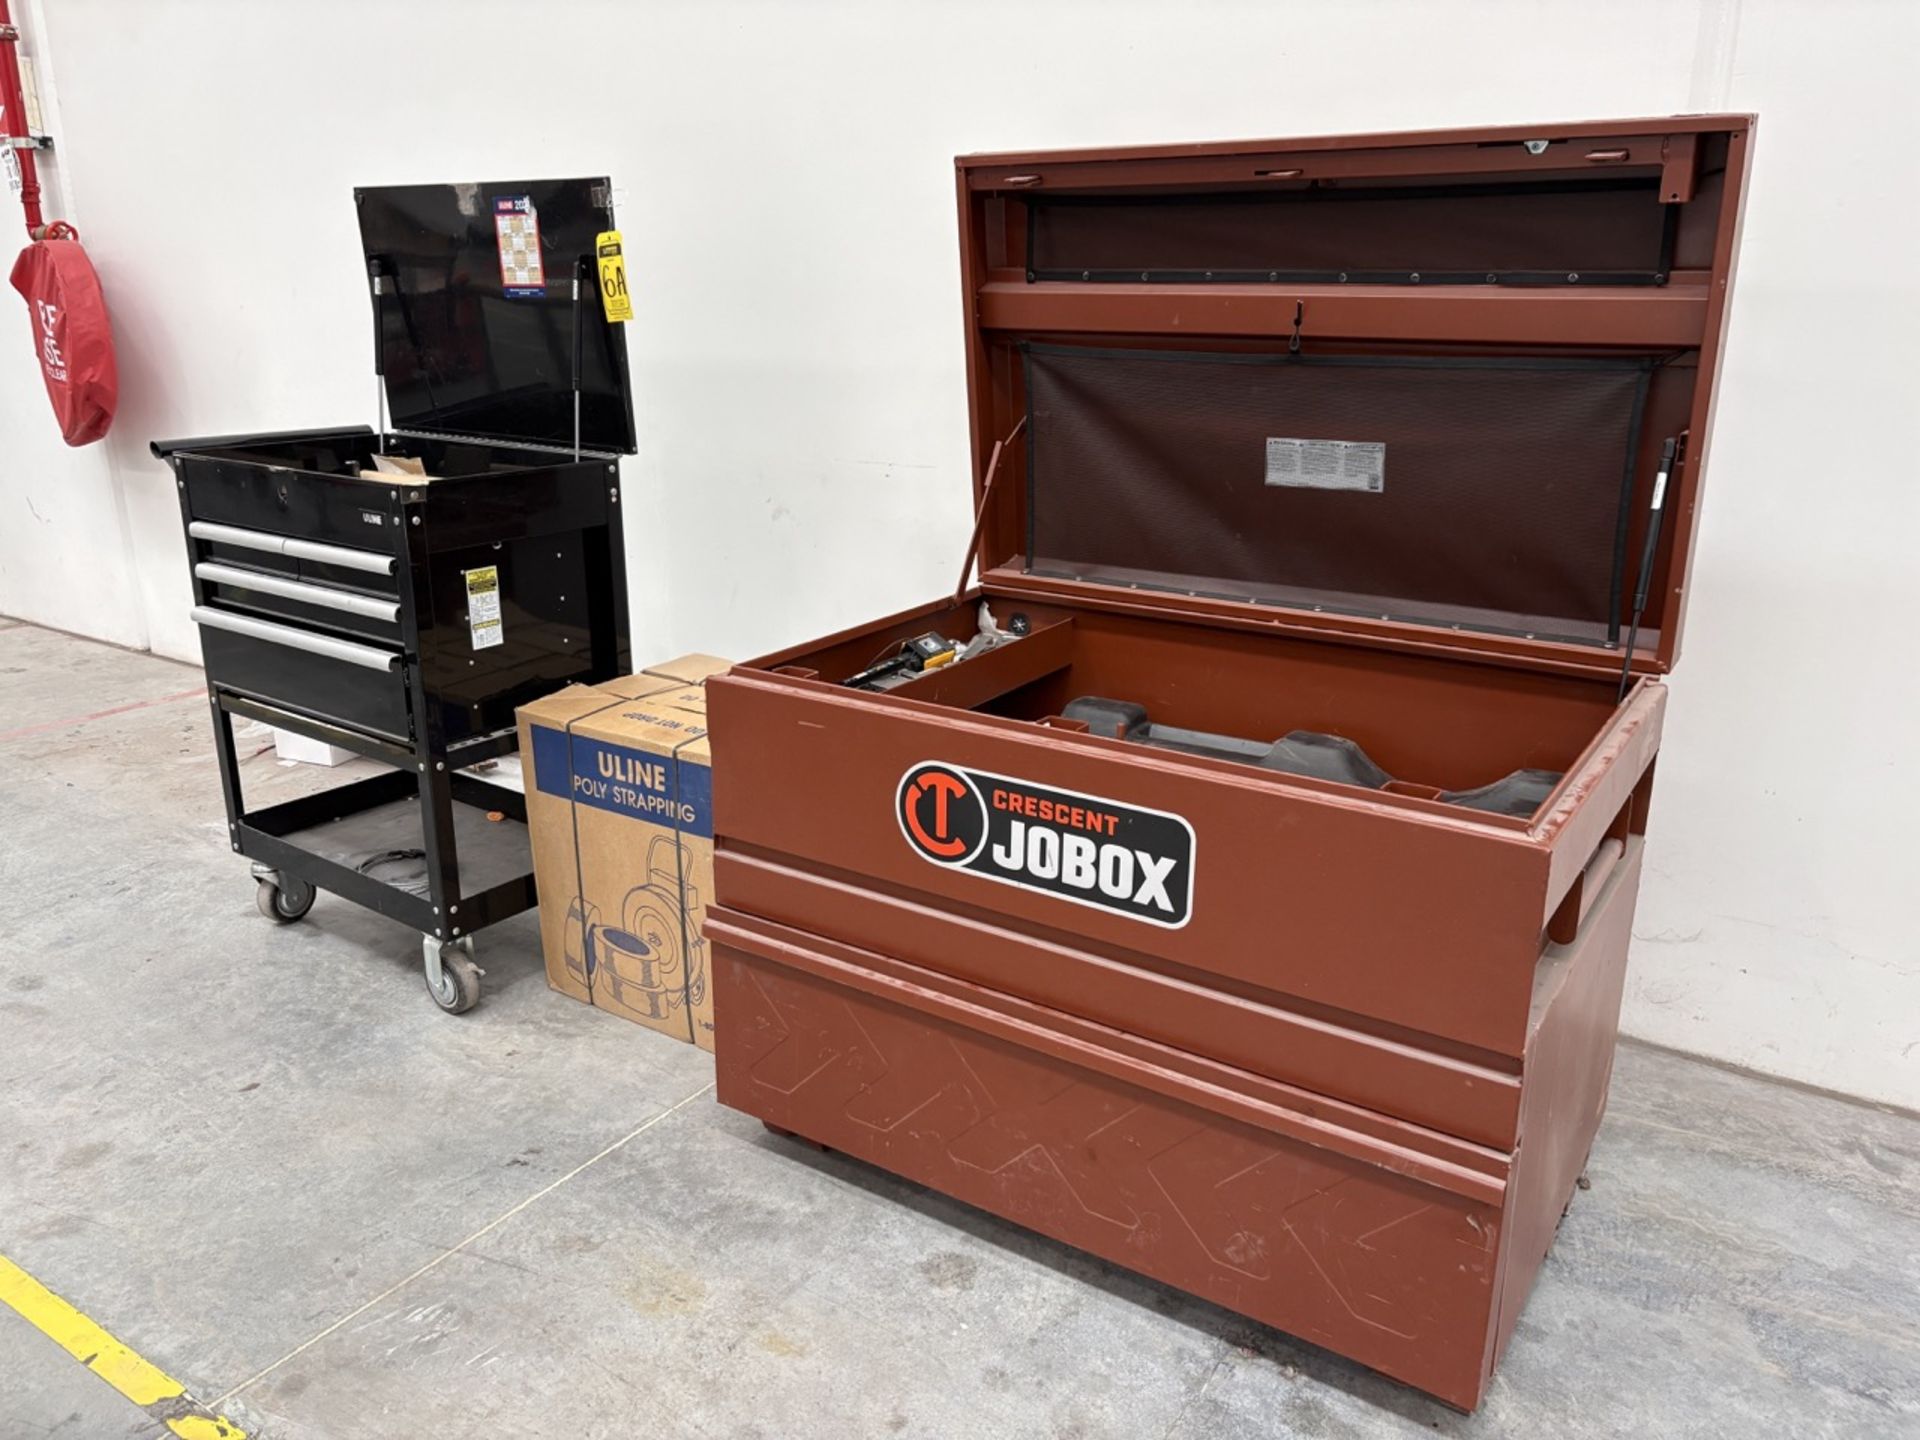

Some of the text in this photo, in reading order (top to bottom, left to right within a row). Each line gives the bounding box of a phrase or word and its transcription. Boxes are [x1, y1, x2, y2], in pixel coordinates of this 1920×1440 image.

[602, 265, 627, 298] 6A
[362, 512, 383, 526] ULINE
[597, 750, 667, 793] ULINE
[573, 774, 696, 823] POLY STRAPPING
[992, 788, 1119, 837] CRESCENT
[992, 820, 1178, 914] JOBOX
